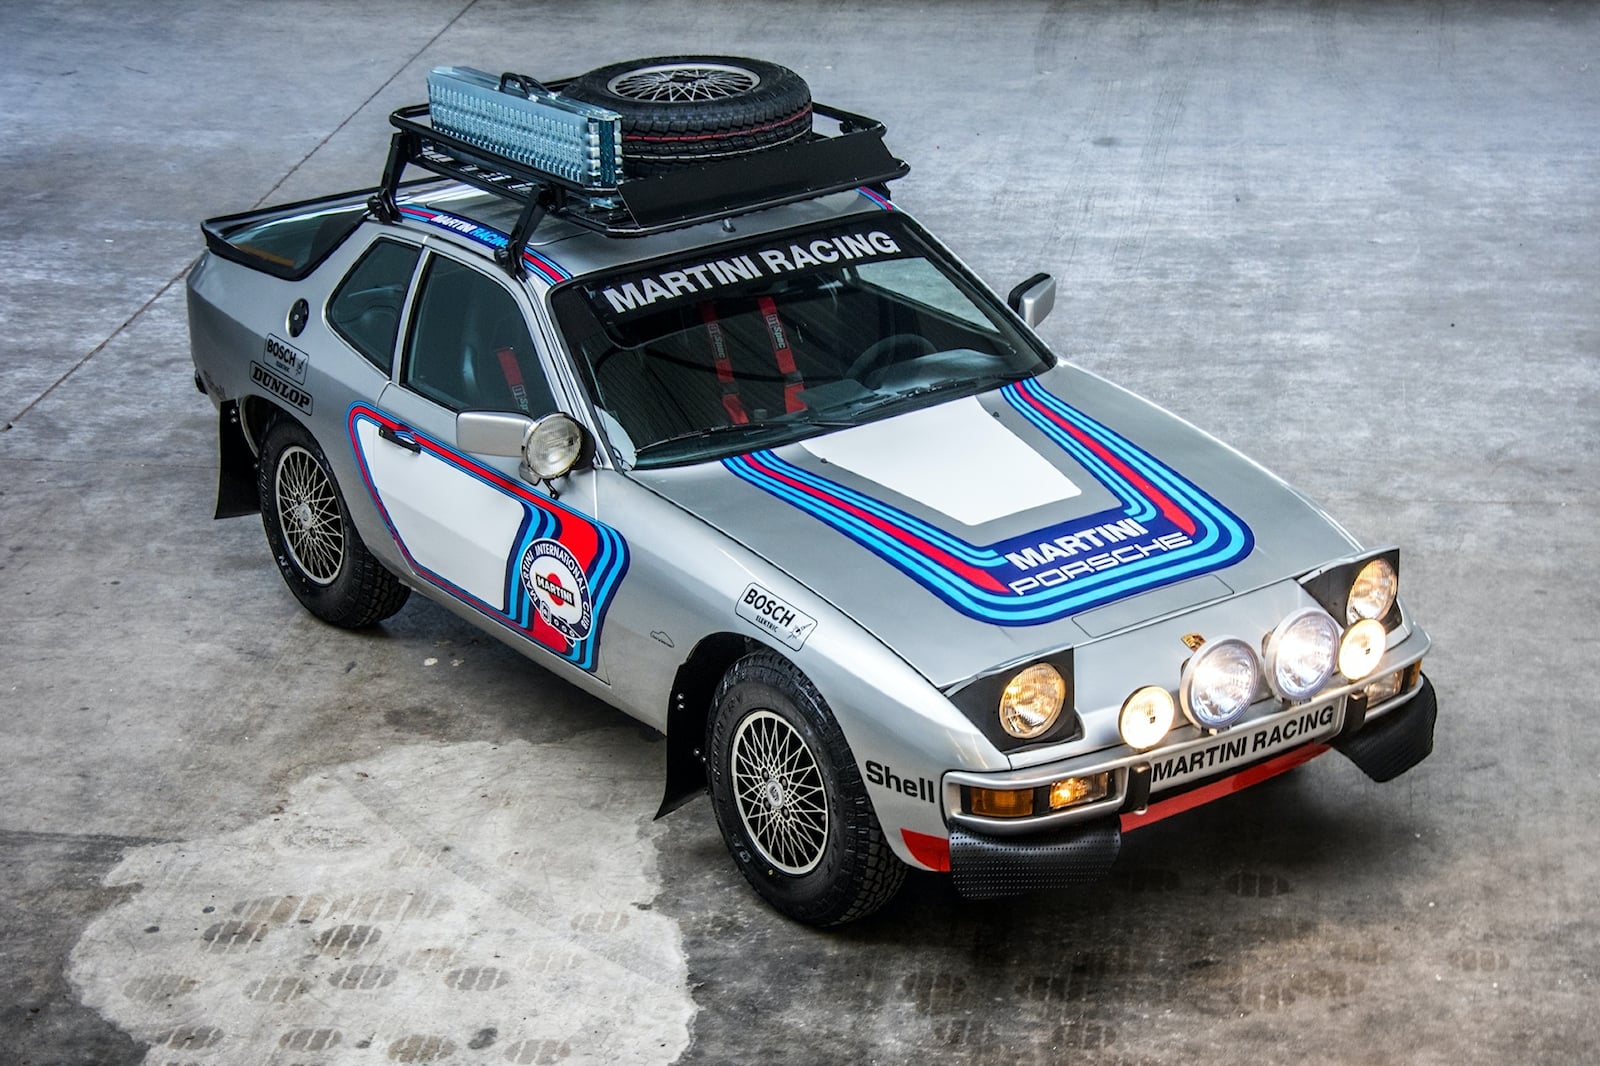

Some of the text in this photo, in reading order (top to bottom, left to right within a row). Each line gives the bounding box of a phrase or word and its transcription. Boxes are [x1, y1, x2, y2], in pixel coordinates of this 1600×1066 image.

[431, 214, 478, 233] MARTINI
[602, 231, 901, 314] MARTINI RACING
[267, 339, 297, 367] BOSCH
[252, 366, 310, 408] DUNLOP
[1005, 518, 1149, 571] MARTINI
[1008, 532, 1193, 596] PORSCHE
[522, 550, 539, 602] MARTINI
[534, 543, 586, 594] INTERNATIONAL
[537, 576, 574, 604] MARTINI
[743, 588, 796, 627] BOSCH
[1152, 705, 1334, 782] MARTINI RACING
[865, 760, 935, 804] Shell
